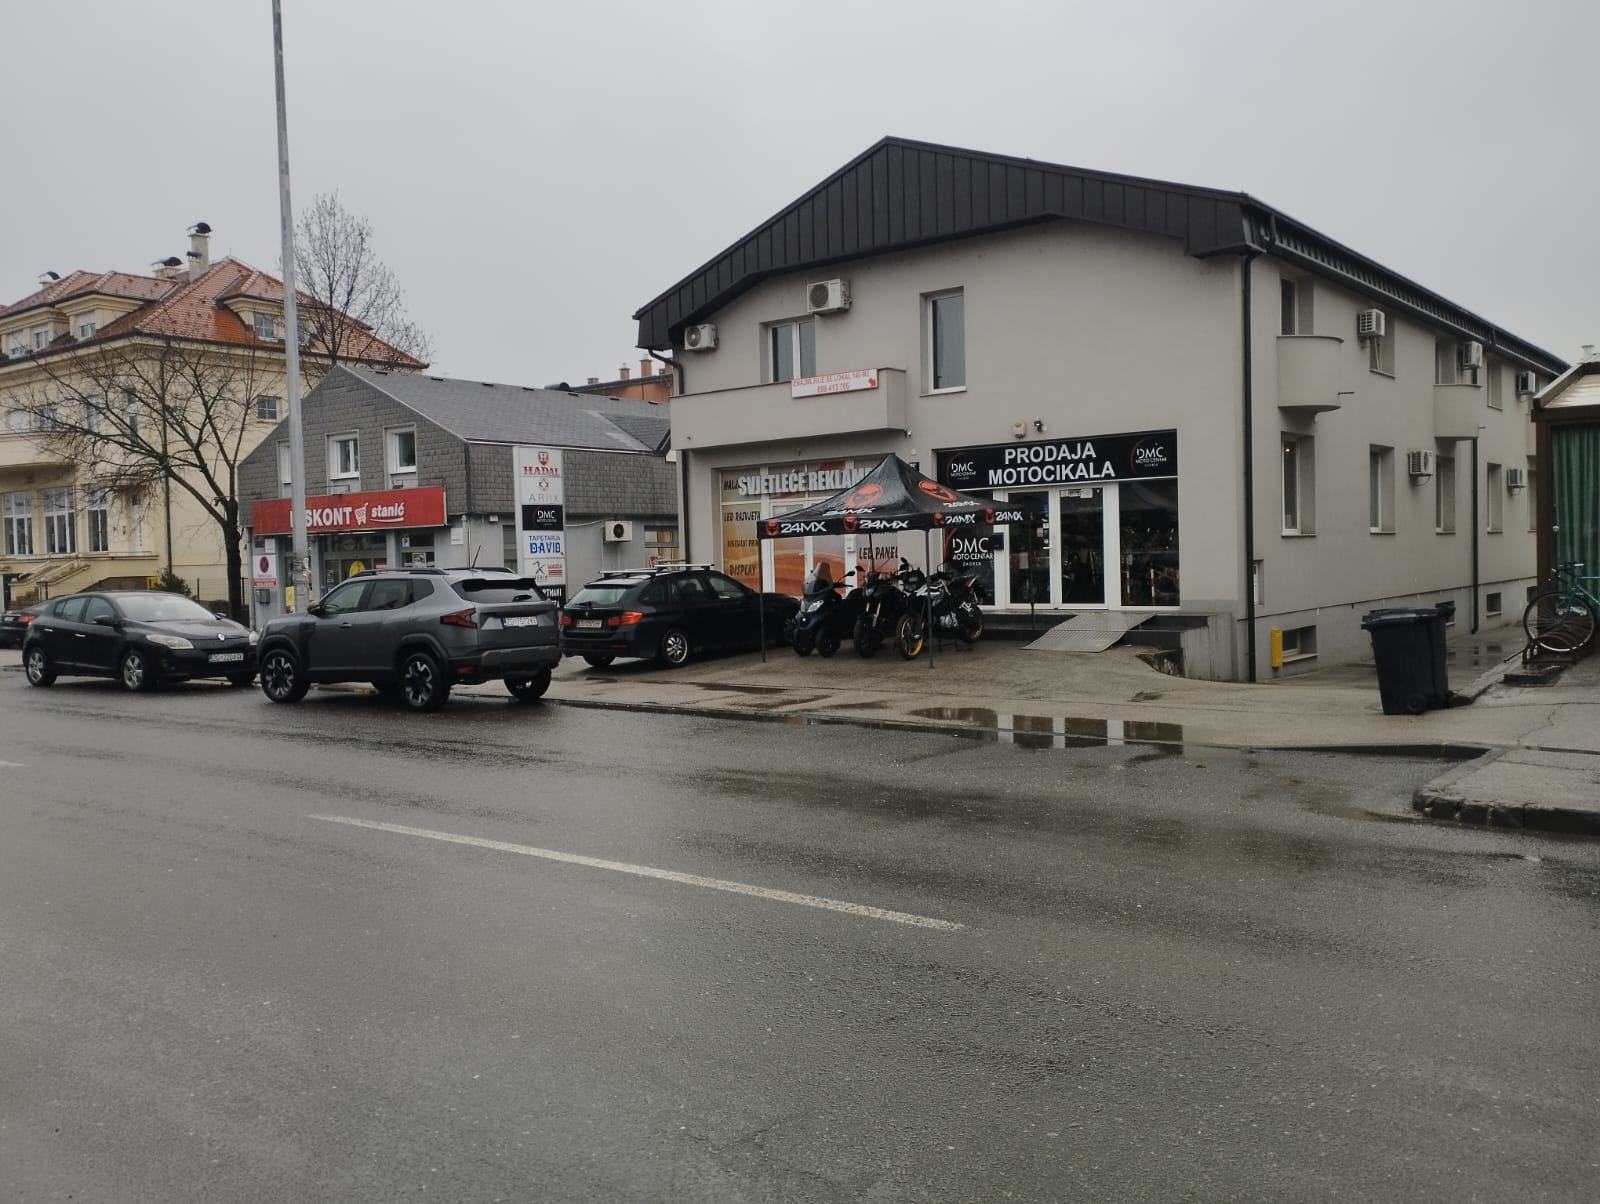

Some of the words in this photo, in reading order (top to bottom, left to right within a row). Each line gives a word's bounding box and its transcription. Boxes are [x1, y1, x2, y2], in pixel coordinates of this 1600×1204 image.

[1004, 441, 1096, 465] PRODAJA
[1136, 446, 1164, 459] DMC
[951, 461, 974, 473] DMC
[988, 461, 1115, 486] MOTOCIKALA
[738, 468, 807, 496] SVJETLEĆE
[290, 507, 352, 528] SKONT
[371, 502, 405, 518] stanić
[537, 510, 555, 519] DMC
[946, 514, 976, 525] 24MX
[995, 510, 1024, 521] 24MX
[781, 522, 827, 534] 24MX
[859, 518, 909, 529] 24MX
[530, 542, 560, 554] DAVID
[952, 537, 989, 553] DMC
